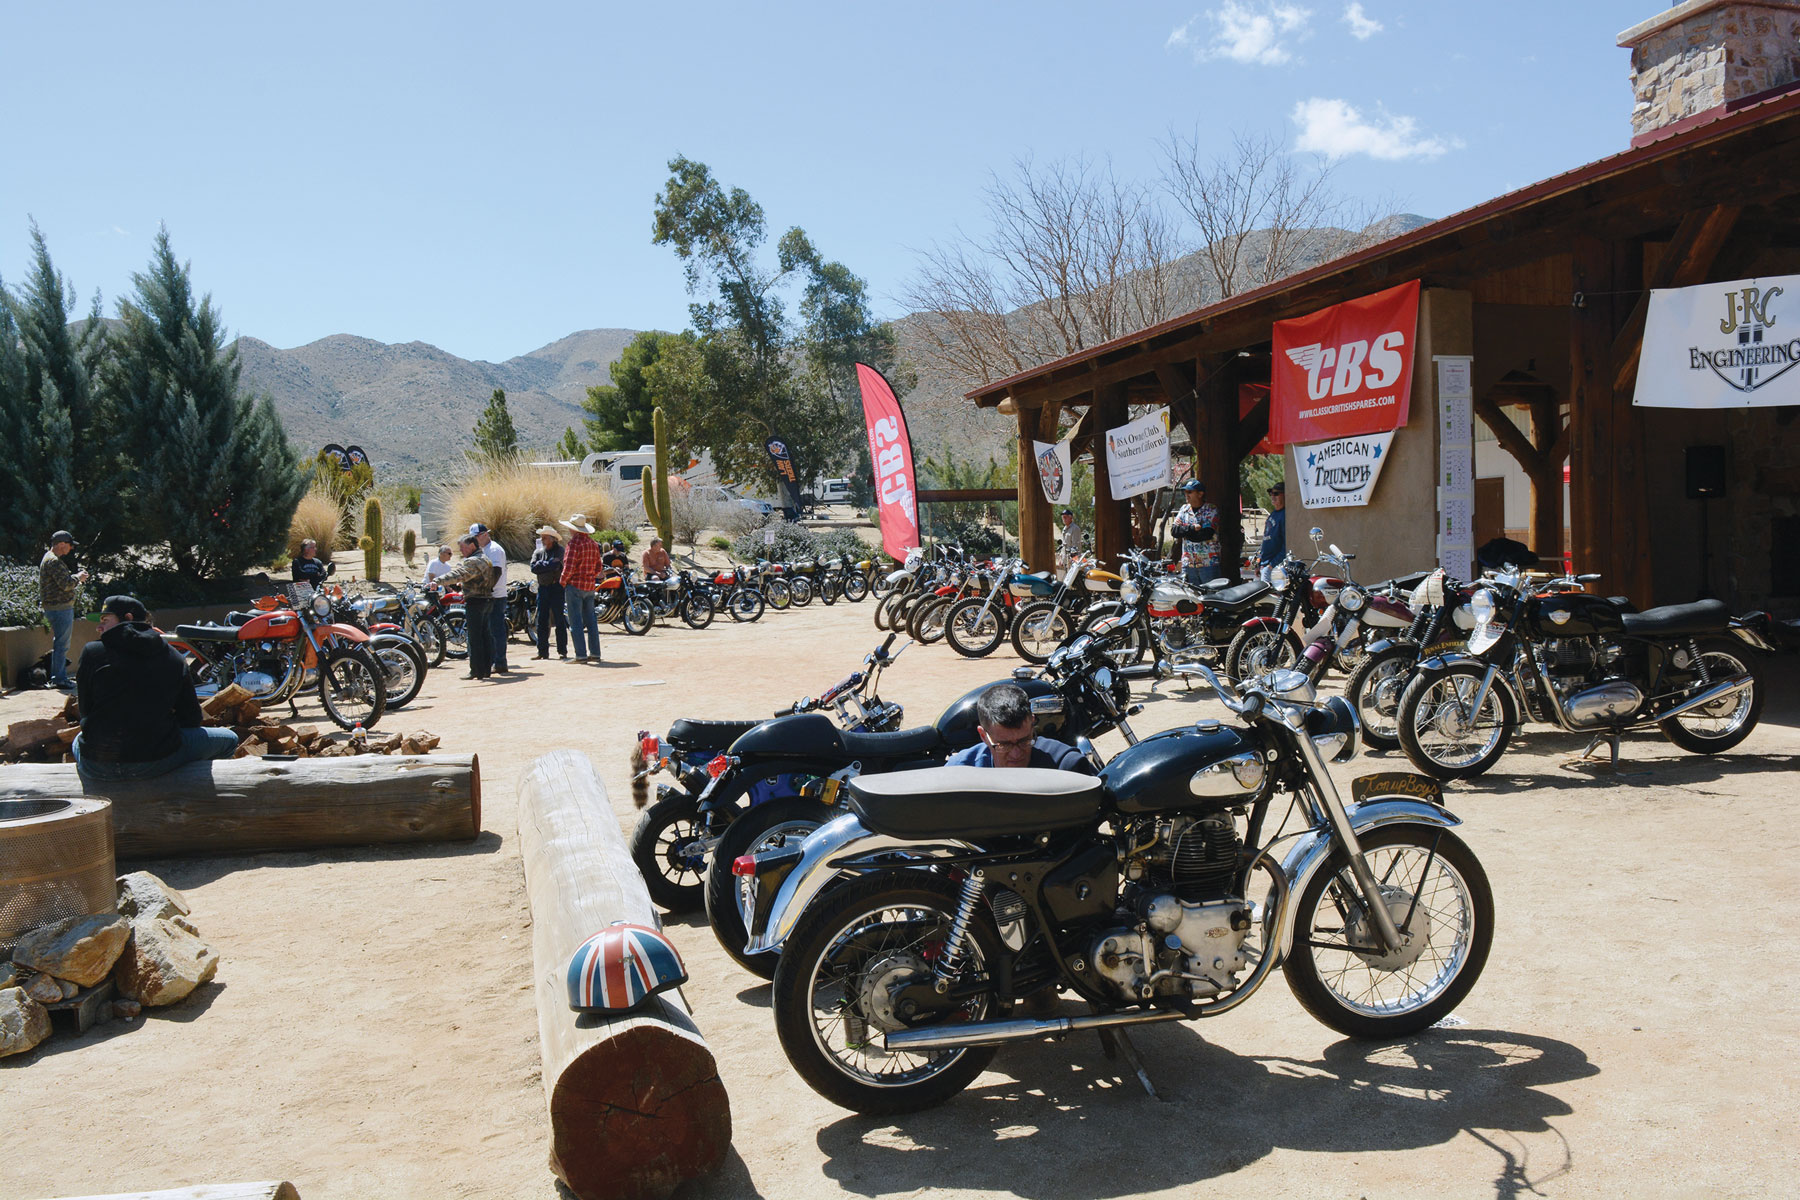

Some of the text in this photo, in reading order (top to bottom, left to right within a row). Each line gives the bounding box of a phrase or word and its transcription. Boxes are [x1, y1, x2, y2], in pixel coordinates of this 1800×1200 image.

[1307, 331, 1405, 401] CBS
[1689, 338, 1800, 370] ENGINEERING
[874, 415, 908, 506] CBS
[1317, 441, 1369, 464] AMERICAN
[1314, 464, 1371, 487] TRIUMPH
[1320, 495, 1341, 504] DIEGO
[1353, 494, 1363, 502] CA
[1359, 774, 1389, 795] Ton
[1405, 774, 1440, 798] Boys
